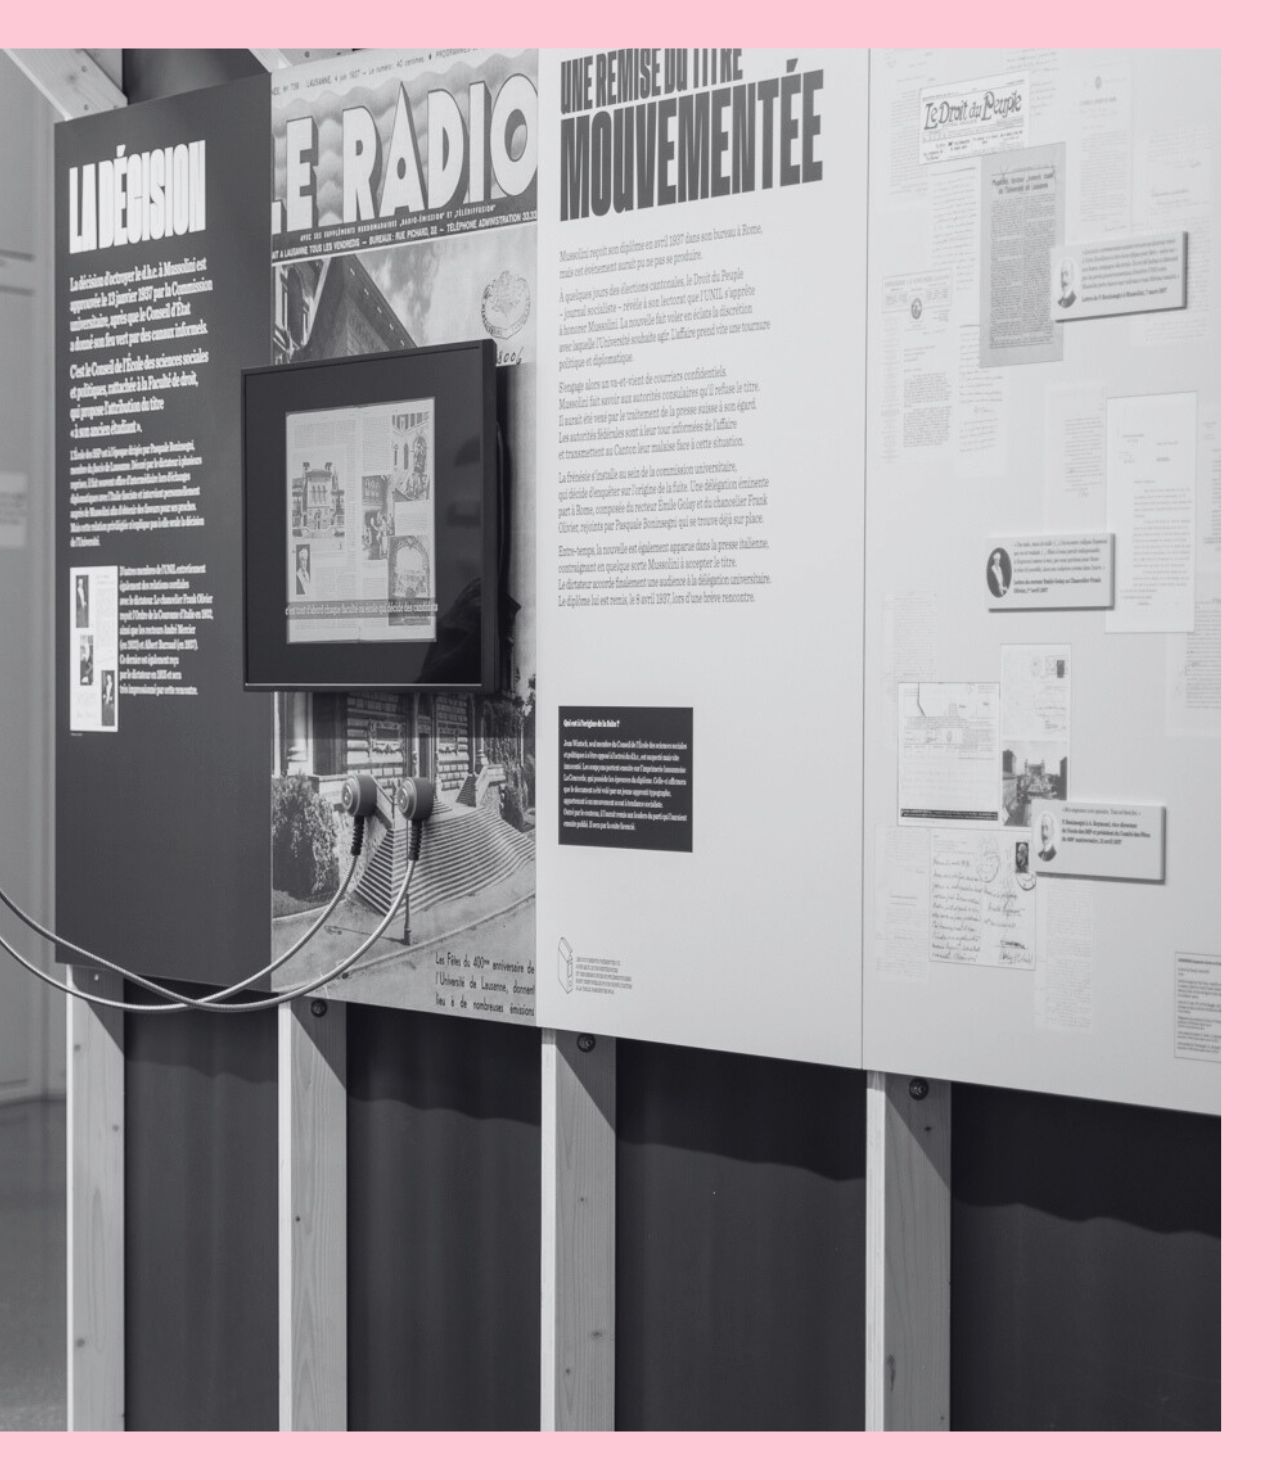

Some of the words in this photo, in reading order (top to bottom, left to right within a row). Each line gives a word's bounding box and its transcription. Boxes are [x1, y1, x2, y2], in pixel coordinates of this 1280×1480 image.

[560, 58, 824, 222] MOUVEMENTÉE
[561, 55, 593, 115] UNE
[596, 48, 661, 108] REMISE
[664, 48, 688, 95] DU
[692, 48, 743, 89] TITRE
[69, 163, 97, 254] LA
[99, 139, 206, 249] DÉCISION
[272, 116, 318, 235] E
[342, 73, 538, 222] RADIO
